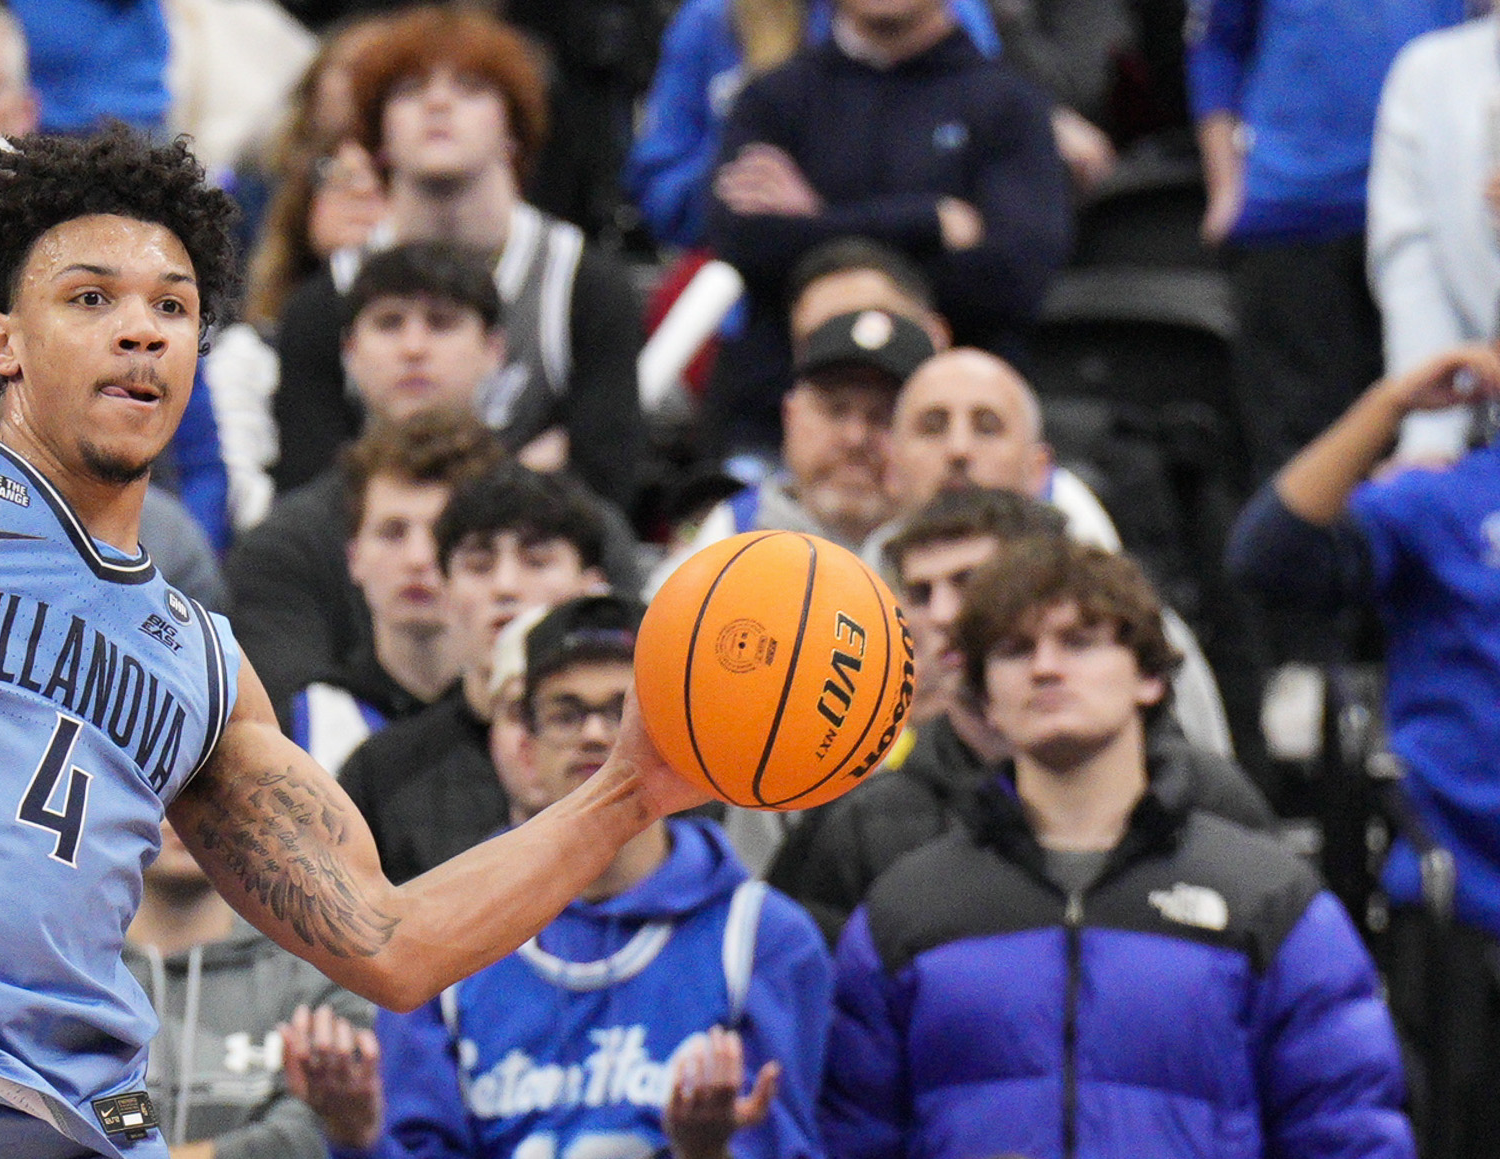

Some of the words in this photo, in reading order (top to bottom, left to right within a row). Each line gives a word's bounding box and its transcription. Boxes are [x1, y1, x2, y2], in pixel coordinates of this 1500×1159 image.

[6, 478, 27, 496] THE
[141, 620, 183, 651] EAST
[147, 613, 178, 637] BIG
[816, 610, 868, 729] EVO
[815, 728, 838, 762] NXT
[16, 712, 94, 869] 4
[584, 1024, 672, 1106] Ha
